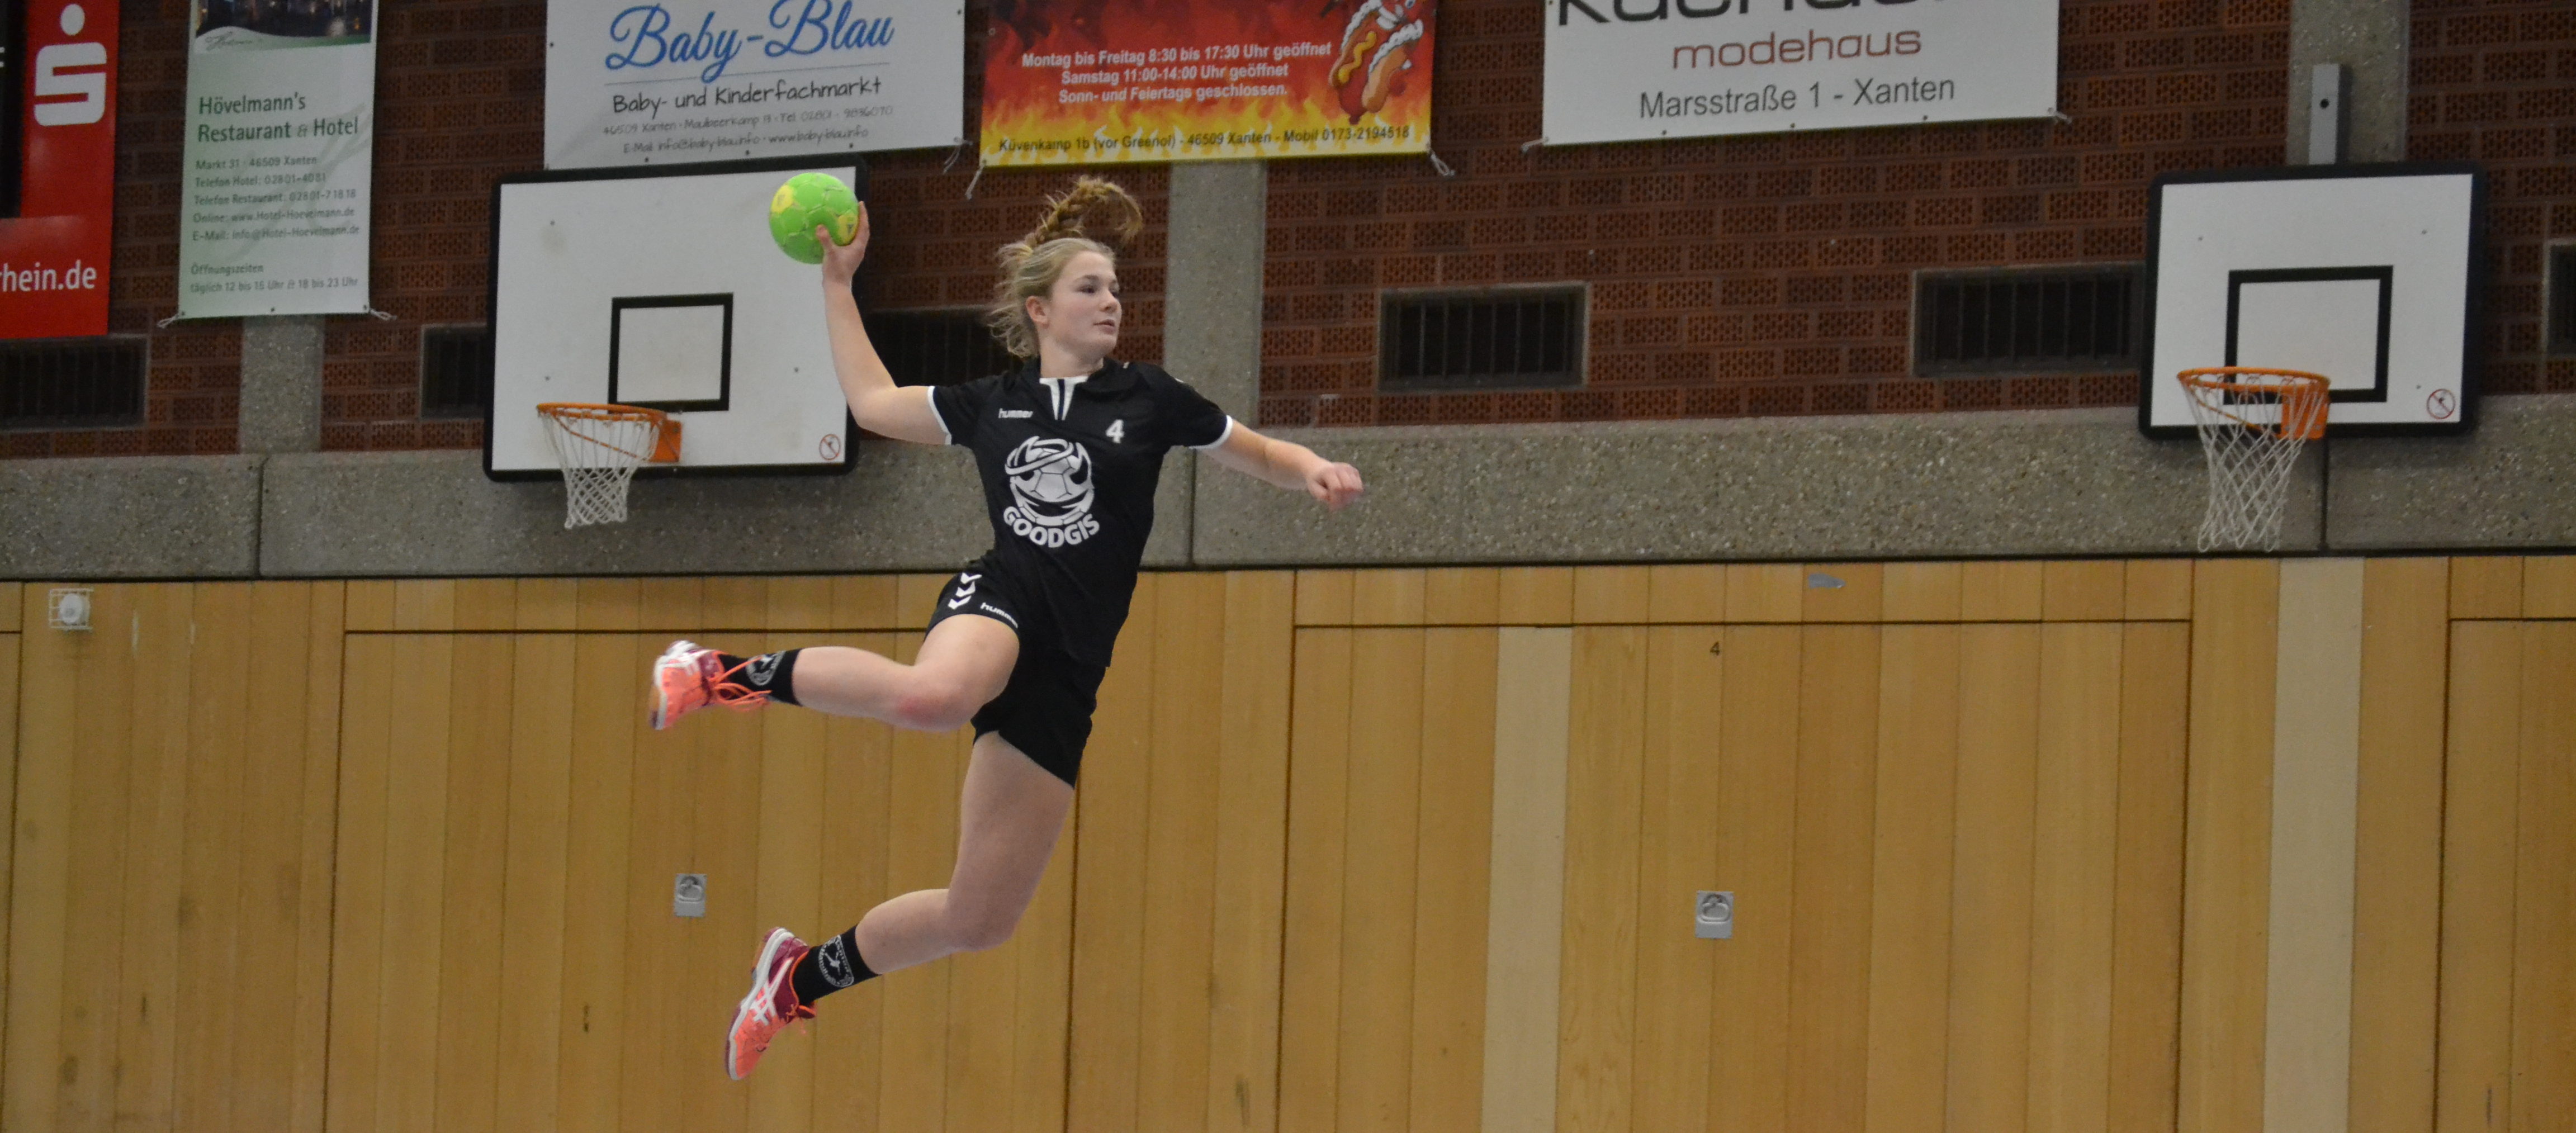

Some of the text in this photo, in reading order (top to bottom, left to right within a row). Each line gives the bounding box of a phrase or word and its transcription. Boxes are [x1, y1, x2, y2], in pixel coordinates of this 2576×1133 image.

[605, 0, 895, 83] Baby-Blau
[1673, 29, 1922, 69] modehaus
[1022, 41, 1332, 68] Montag bis Freitag 8:30 bis 17:30 Uhr geöffnet
[1062, 63, 1289, 86] Samstag 11:00-14:00 Uhr geöffnet
[199, 92, 306, 114] Hövelmann's
[613, 76, 882, 120] Baby- und Kinderfachmarkt
[1059, 83, 1287, 103] Sonn- und Feiertags geschlossen.
[1640, 84, 1797, 118] Marsstraße
[1810, 81, 1820, 107] 1
[1853, 76, 1954, 106] Xanten
[198, 116, 358, 142] Restaurant & Hotel
[643, 121, 676, 133] Xanten
[1188, 132, 1224, 145] 46509
[1228, 131, 1271, 144] Xanten
[196, 159, 226, 170] Markt
[249, 157, 281, 167] 46509
[284, 155, 318, 166] Xanten
[196, 176, 230, 188] Telefon
[195, 194, 230, 205] Telefon
[0, 259, 97, 292] hein.de
[191, 262, 264, 276] Öffnungszeiten
[190, 282, 222, 294] täglich
[225, 282, 235, 292] 12
[239, 281, 252, 291] bis
[268, 280, 284, 290] Uhr
[312, 278, 324, 288] bis
[327, 277, 339, 288] 23
[342, 276, 358, 286] Uhr
[1106, 419, 1125, 443] 4
[1003, 506, 1100, 548] GOODGIS
[1710, 641, 1720, 656] 4
